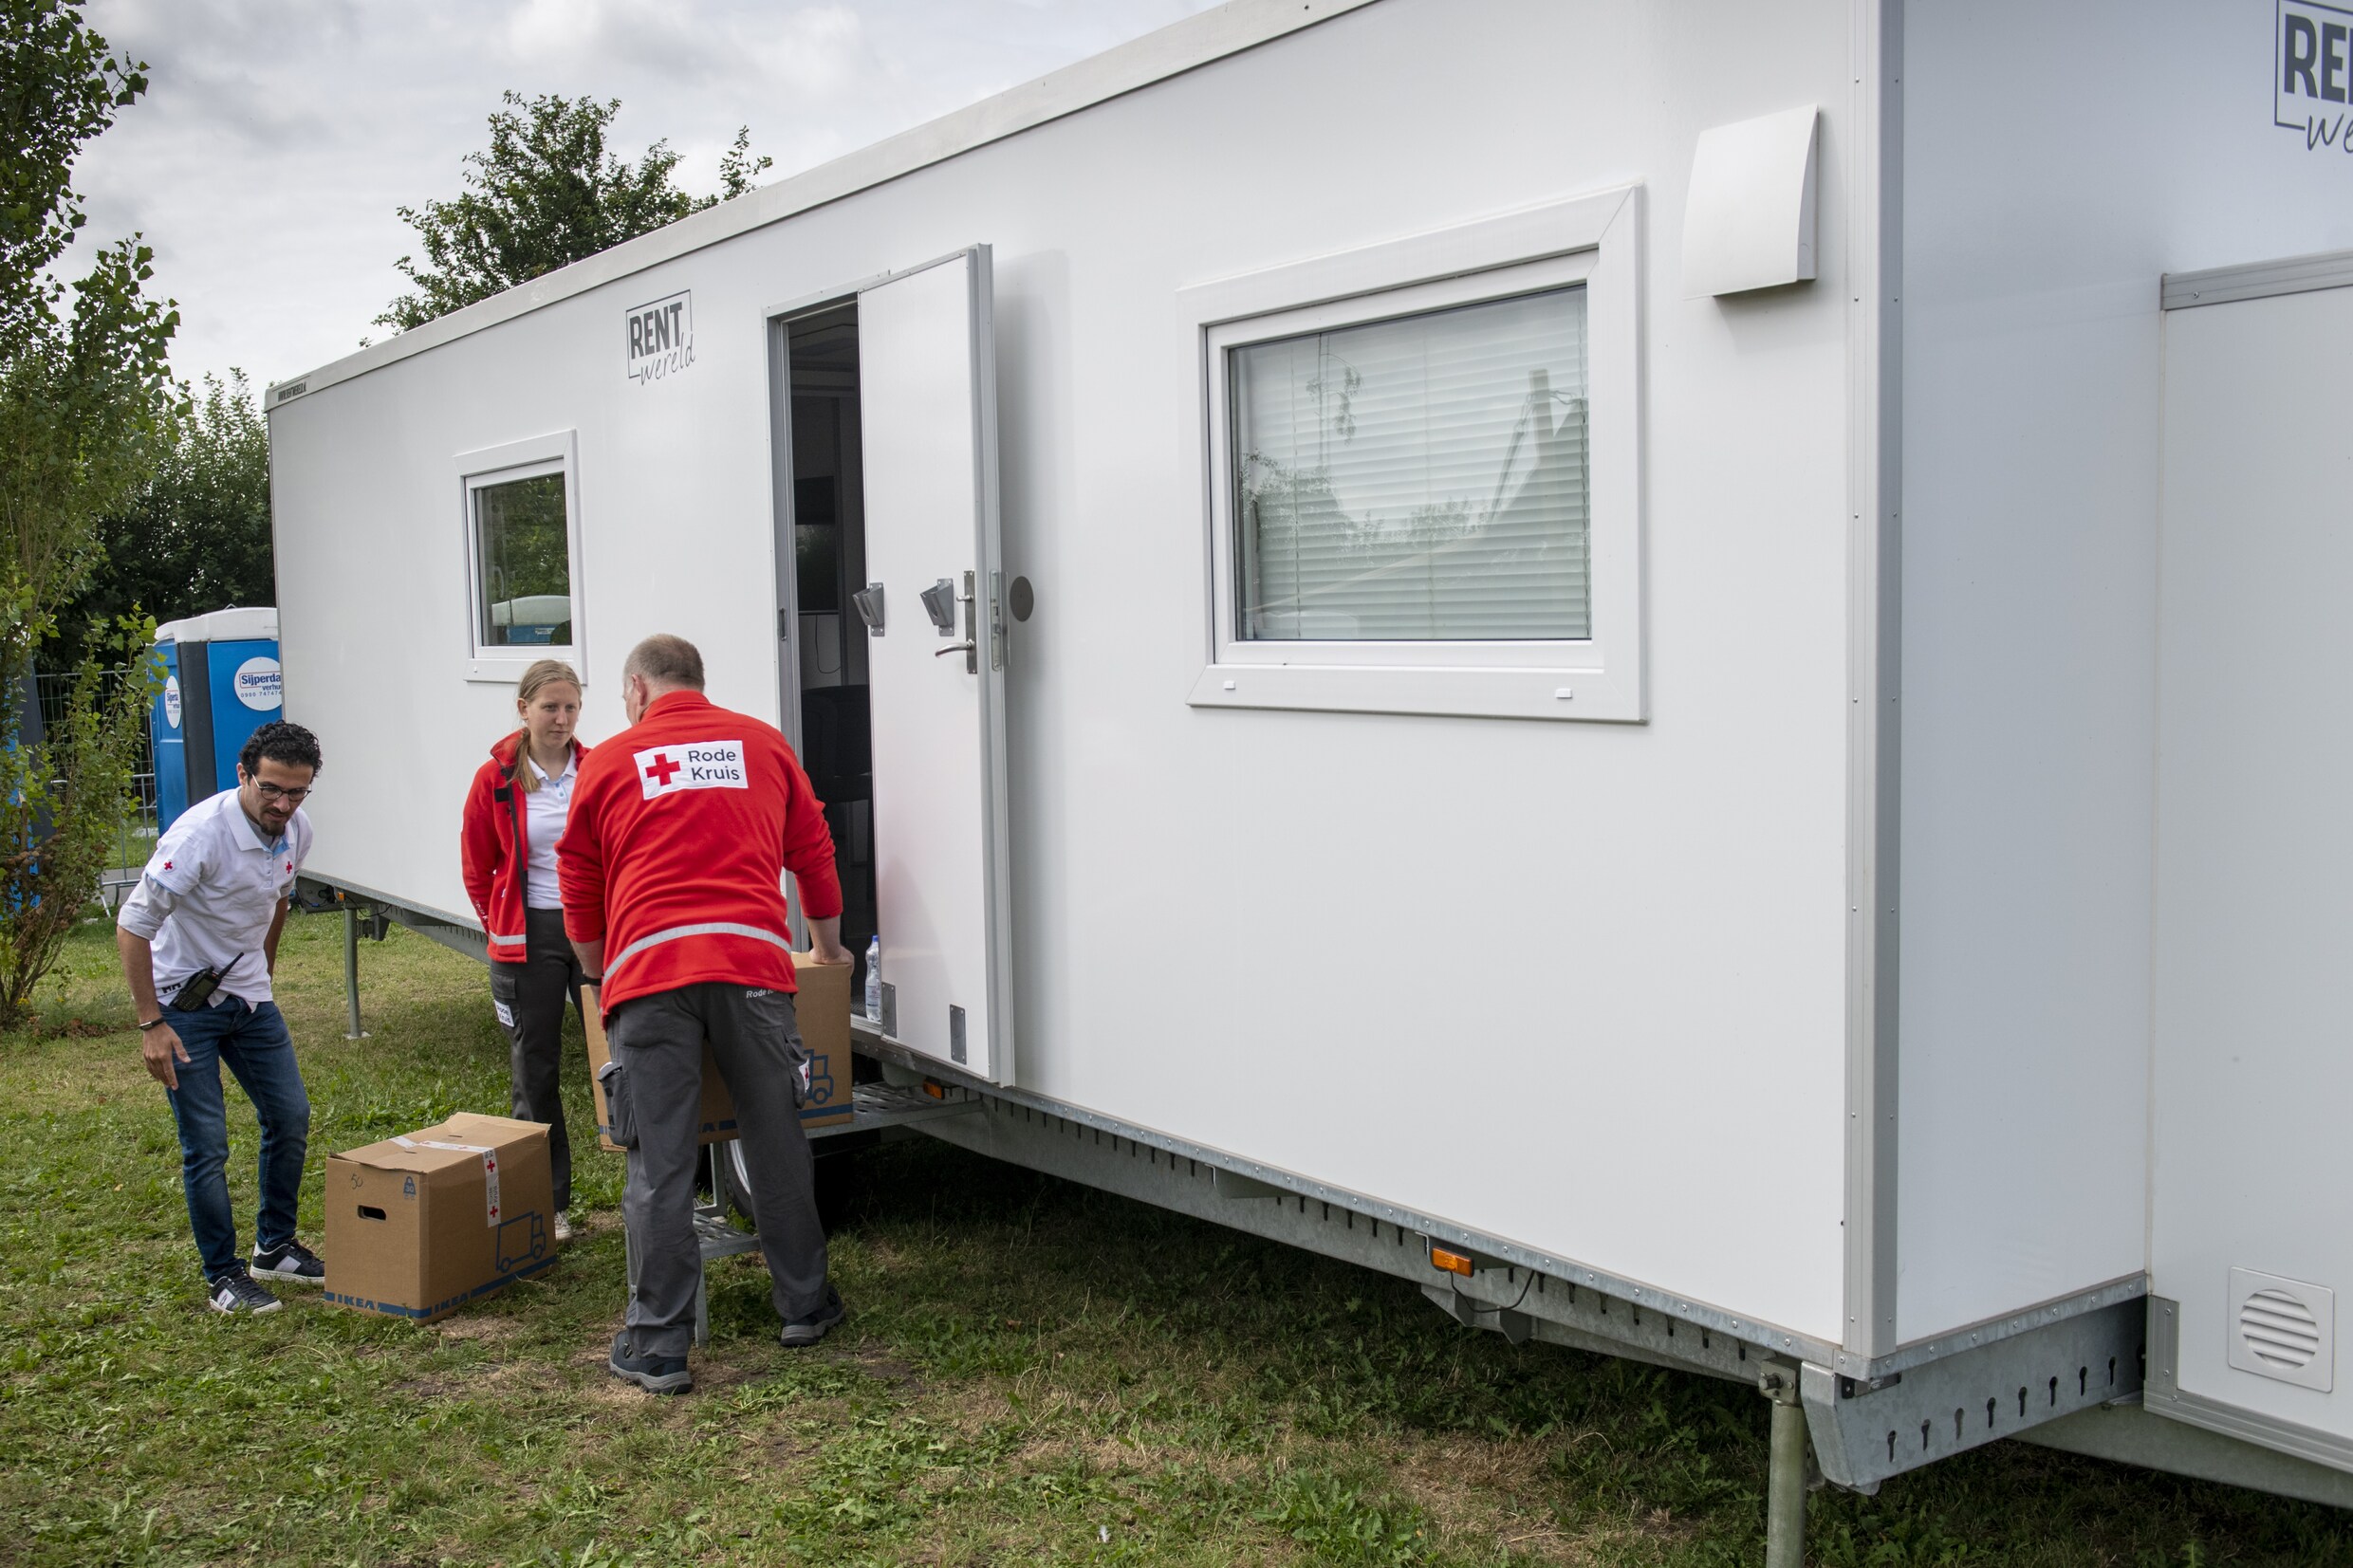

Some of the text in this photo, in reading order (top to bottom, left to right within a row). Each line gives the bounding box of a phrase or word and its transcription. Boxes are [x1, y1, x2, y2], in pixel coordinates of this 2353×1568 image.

[629, 302, 682, 360] RENT
[640, 332, 695, 386] wereld
[688, 748, 736, 763] Rode
[691, 766, 740, 781] Kruis
[746, 988, 767, 998] Rode
[338, 1293, 375, 1310] IKEA
[435, 1291, 469, 1313] IKEA
